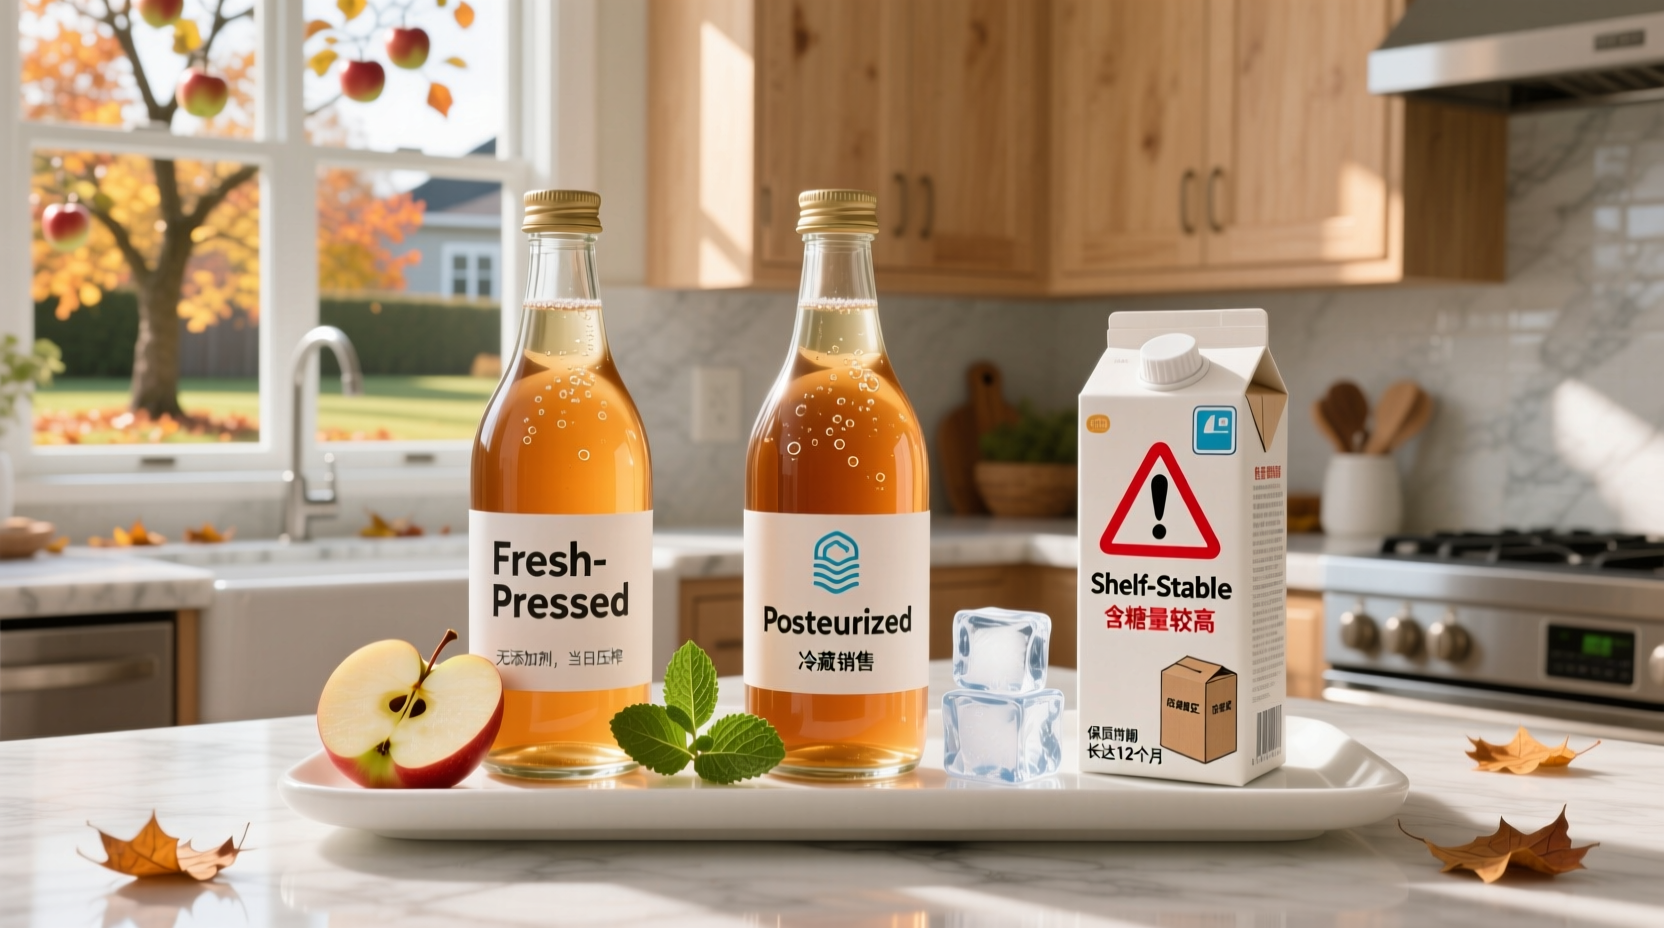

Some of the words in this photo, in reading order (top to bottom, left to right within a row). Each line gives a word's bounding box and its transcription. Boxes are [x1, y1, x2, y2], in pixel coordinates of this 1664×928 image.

[493, 540, 607, 578] Fresh-
[493, 581, 629, 620] Pressed
[1091, 571, 1233, 600] Shelf-Stable
[763, 605, 912, 636] Posteurized
[1104, 604, 1216, 634] 含糖量较高
[798, 649, 875, 673] 冷藏销售
[1087, 743, 1164, 765] 长达12个月
